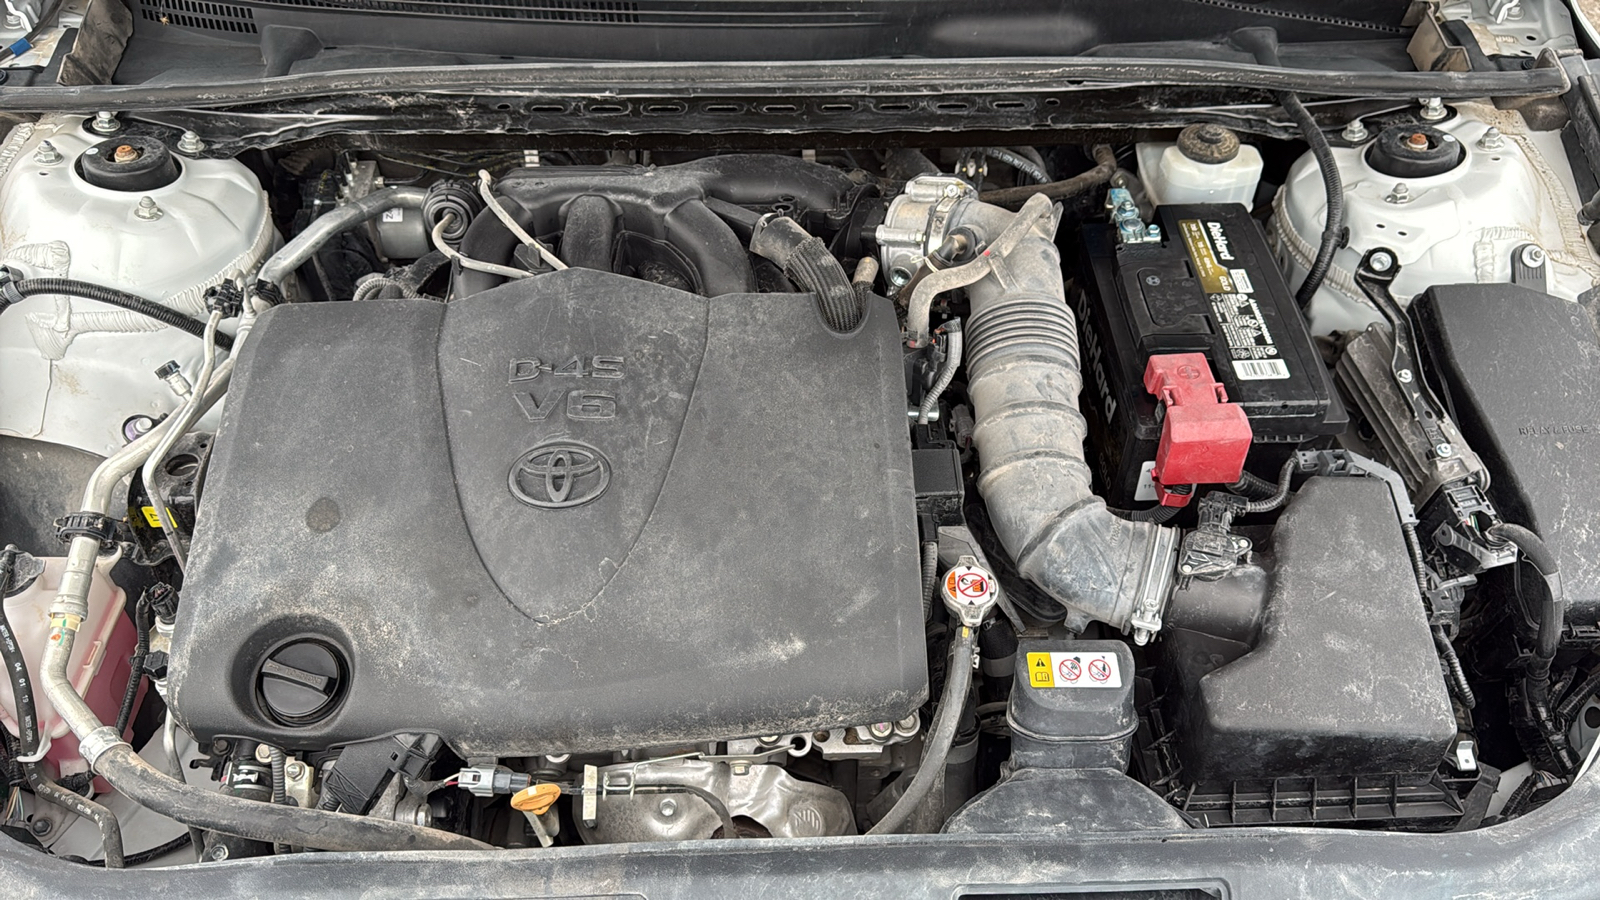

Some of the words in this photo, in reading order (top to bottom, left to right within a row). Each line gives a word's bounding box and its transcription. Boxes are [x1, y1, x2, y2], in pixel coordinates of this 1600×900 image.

[1207, 222, 1235, 260] DieHard
[1219, 275, 1231, 291] GOLD
[1078, 288, 1117, 424] DieHard
[508, 355, 625, 384] D-4S
[513, 389, 618, 422] V6
[1518, 426, 1550, 436] RELAY
[1561, 424, 1590, 434] FUSE
[14, 662, 22, 672] 04
[19, 678, 26, 687] 01
[22, 694, 29, 703] 19
